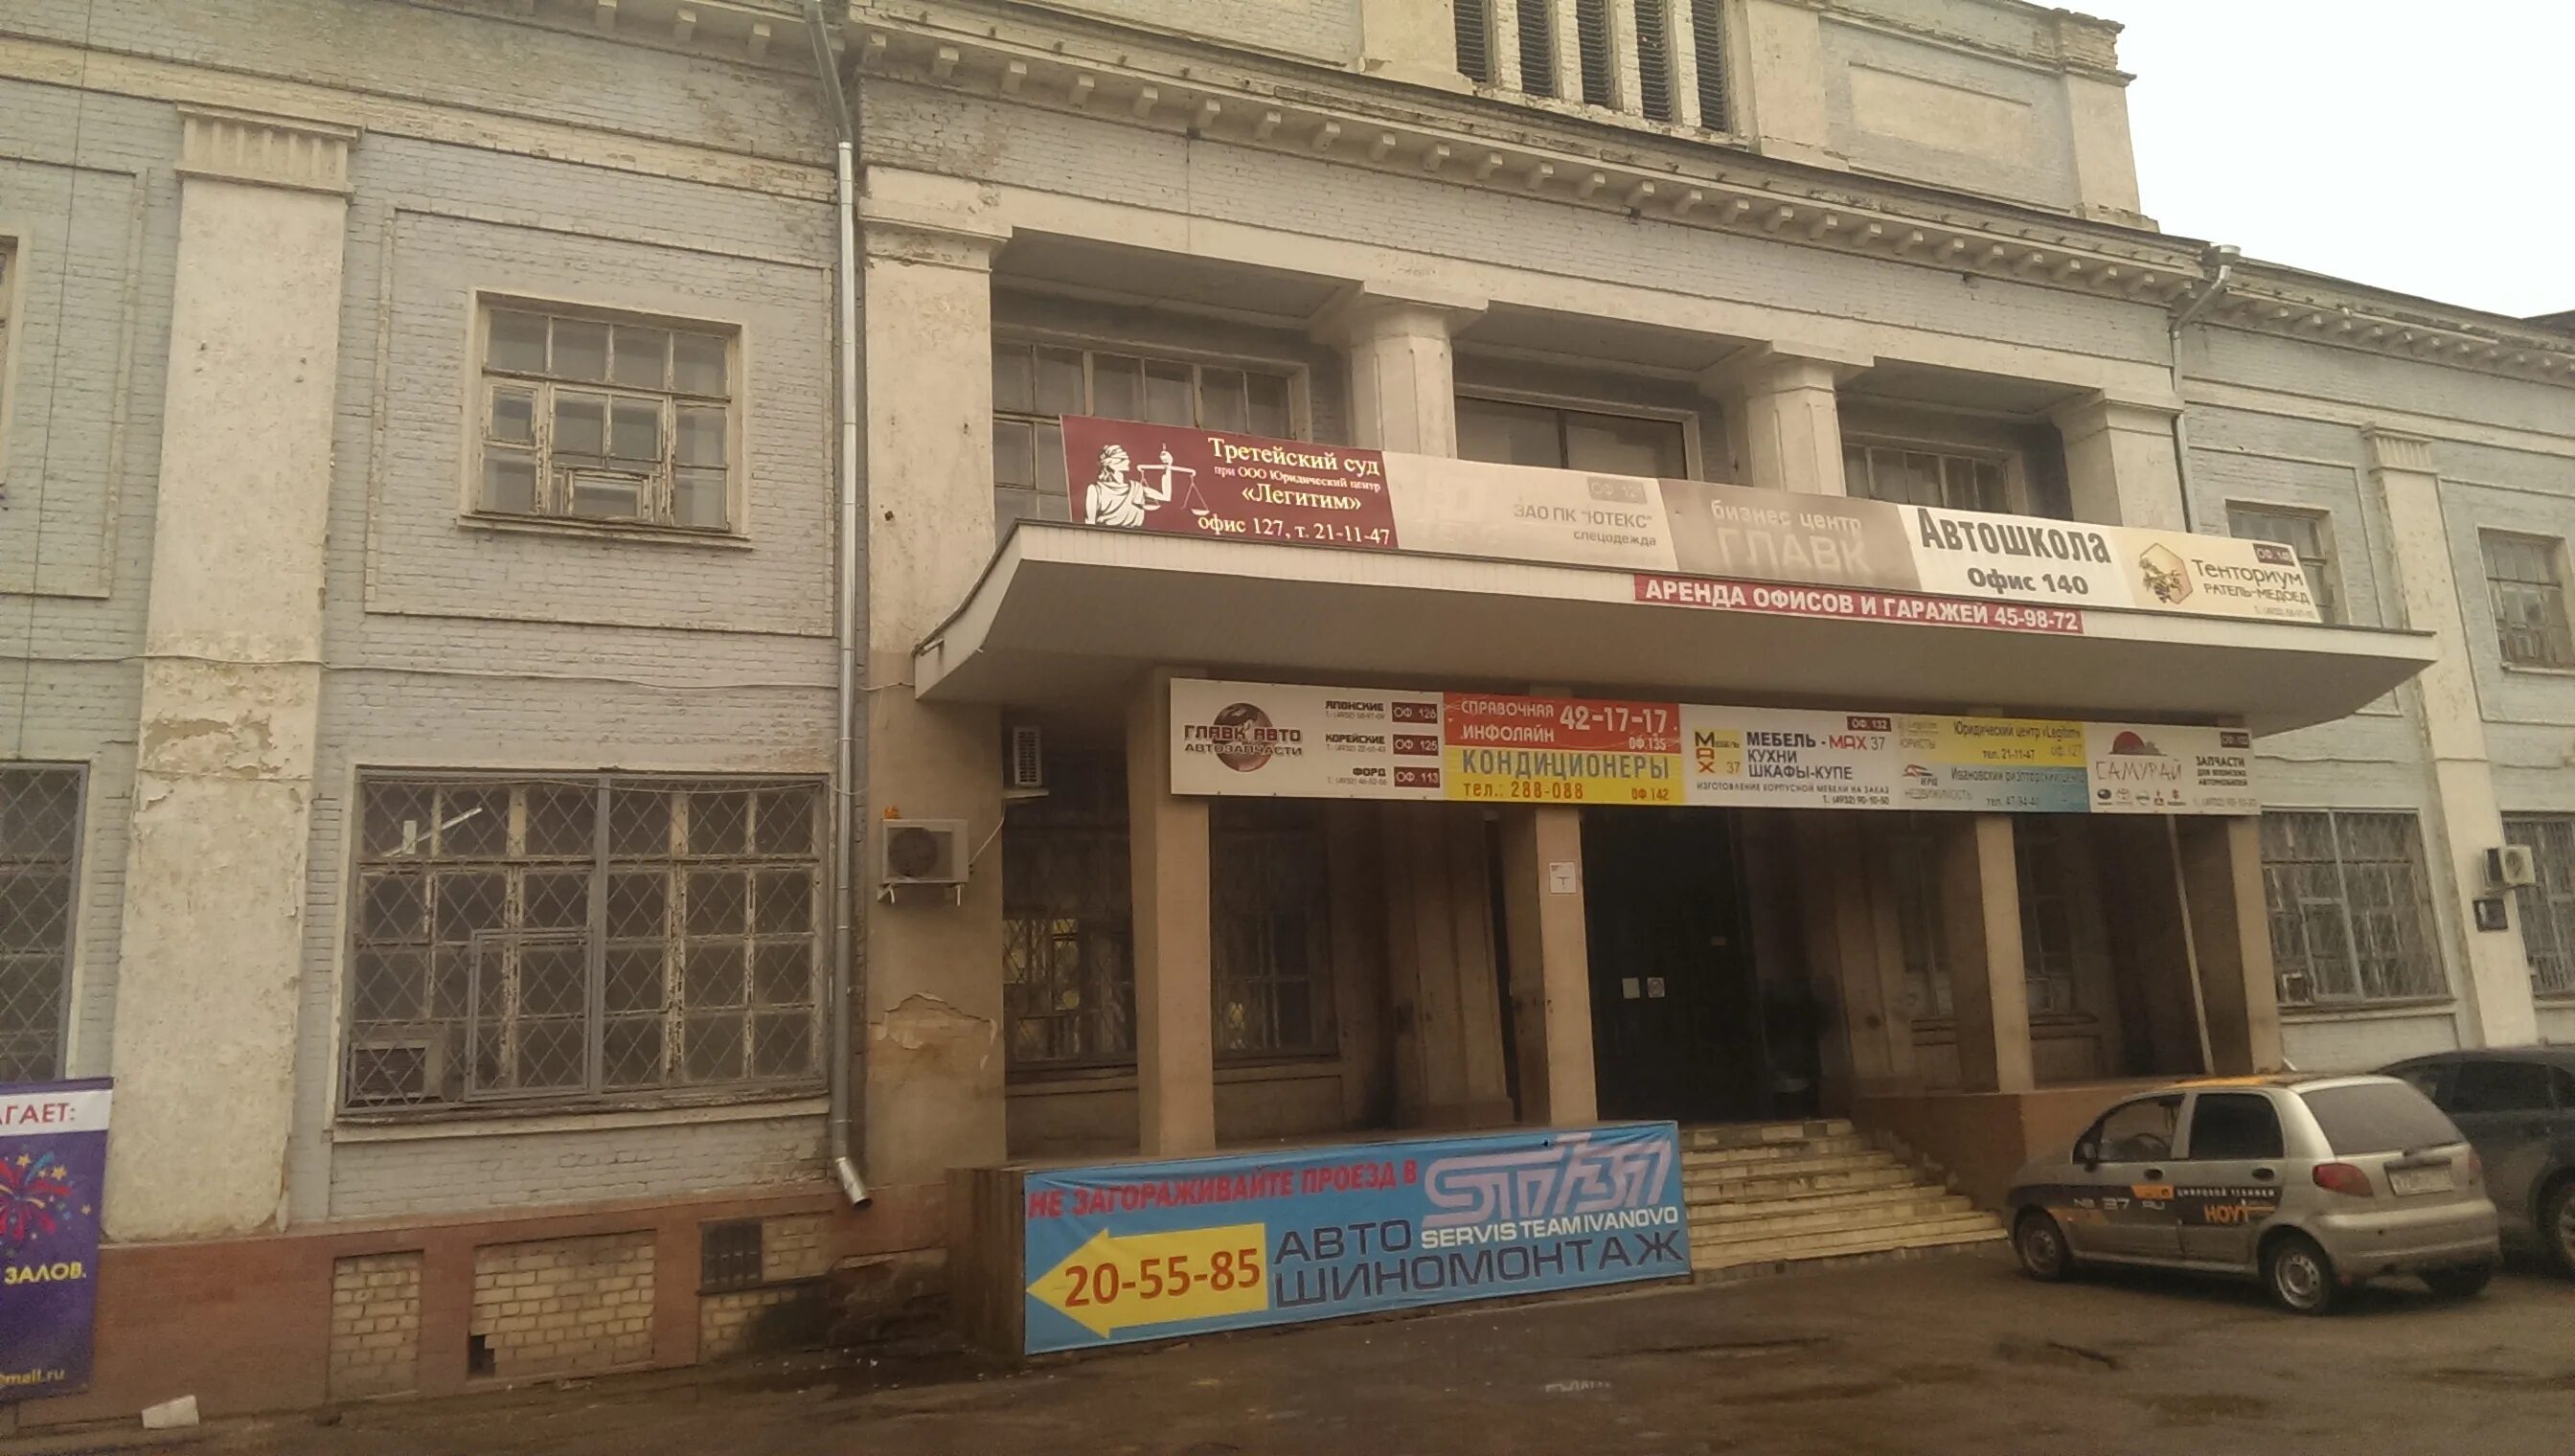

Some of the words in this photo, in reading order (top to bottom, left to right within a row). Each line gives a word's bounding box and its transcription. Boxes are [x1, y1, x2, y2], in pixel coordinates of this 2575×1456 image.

[1208, 438, 1338, 470] Третейский
[1343, 456, 1380, 477] суд
[1214, 466, 1236, 480] при
[1239, 466, 1267, 480] ООО
[1242, 483, 1361, 511] «Легитим»
[1514, 504, 1549, 520] ЗАО
[1553, 507, 1577, 522] ПК
[1710, 500, 1791, 528] бизнес
[1799, 510, 1862, 532] центр
[1197, 513, 1245, 535] офис
[1254, 518, 1290, 539] 127,
[1294, 525, 1310, 538] т.
[1314, 524, 1390, 545] 21-11-47
[1573, 530, 1656, 547] спецодежда
[1918, 508, 2112, 564] Автошкола
[1716, 528, 1872, 575] ГЛАВК
[1968, 567, 2036, 594] Офис
[2042, 572, 2089, 595] 140
[2191, 558, 2304, 589] Тенториум
[2203, 582, 2312, 605] РАТЕЛЬ-МЕДОЕД
[1646, 580, 1746, 608] АРЕНДА
[1752, 586, 1854, 614] ОФИСОВ
[1861, 595, 1877, 616] И
[1883, 596, 1990, 626] ГАРАЖЕЙ
[1994, 603, 2079, 631] 45-98-72
[1461, 700, 1554, 717] СПРАВОЧНАЯ
[1560, 705, 1668, 734] 42-17-17
[1871, 719, 1888, 730] 132
[1184, 724, 1246, 740] ГЛАВК
[1254, 728, 1302, 742] АВТО
[1325, 733, 1385, 744] КОРЕЙСКИЕ
[1463, 723, 1555, 742] ИНФОЛАЙН
[1746, 731, 1816, 748] МЕБЕЛЬ
[1871, 737, 1886, 751] 37
[1184, 743, 1303, 757] АВТОЗАПЧАСТИ
[1420, 739, 1437, 751] 125
[1747, 748, 1797, 763] КУХНИ
[1353, 767, 1386, 777] ФОРД
[1462, 749, 1669, 781] КОНДИЦИОНЕРЫ
[1726, 762, 1741, 775] 37
[1748, 764, 1854, 780] ШКАФЫ-КУПЕ
[2095, 759, 2182, 781] САМУРАЙ
[2196, 756, 2245, 767] ЗАПЧАСТИ
[1422, 772, 1439, 784] 113
[1511, 781, 1584, 799] 288-088
[0, 1102, 77, 1126] ГАЕТ:
[1028, 1190, 1064, 1219] НЕ
[1071, 1163, 1295, 1217] ЗАГОРАЖИВАЙТЕ
[1301, 1160, 1396, 1194] ПРОЕЗД
[1402, 1159, 1418, 1187] В
[2102, 1197, 2131, 1211] 37
[1421, 1221, 1516, 1250] SERVIS
[1519, 1215, 1584, 1239] TEAM
[1584, 1206, 1678, 1233] IVANOVO
[1274, 1218, 1412, 1264] АВТО
[4, 1261, 87, 1285] ЗАЛОВ.
[1064, 1247, 1262, 1308] 20-55-85
[1275, 1230, 1685, 1309] ШИНОМОНТАЖ
